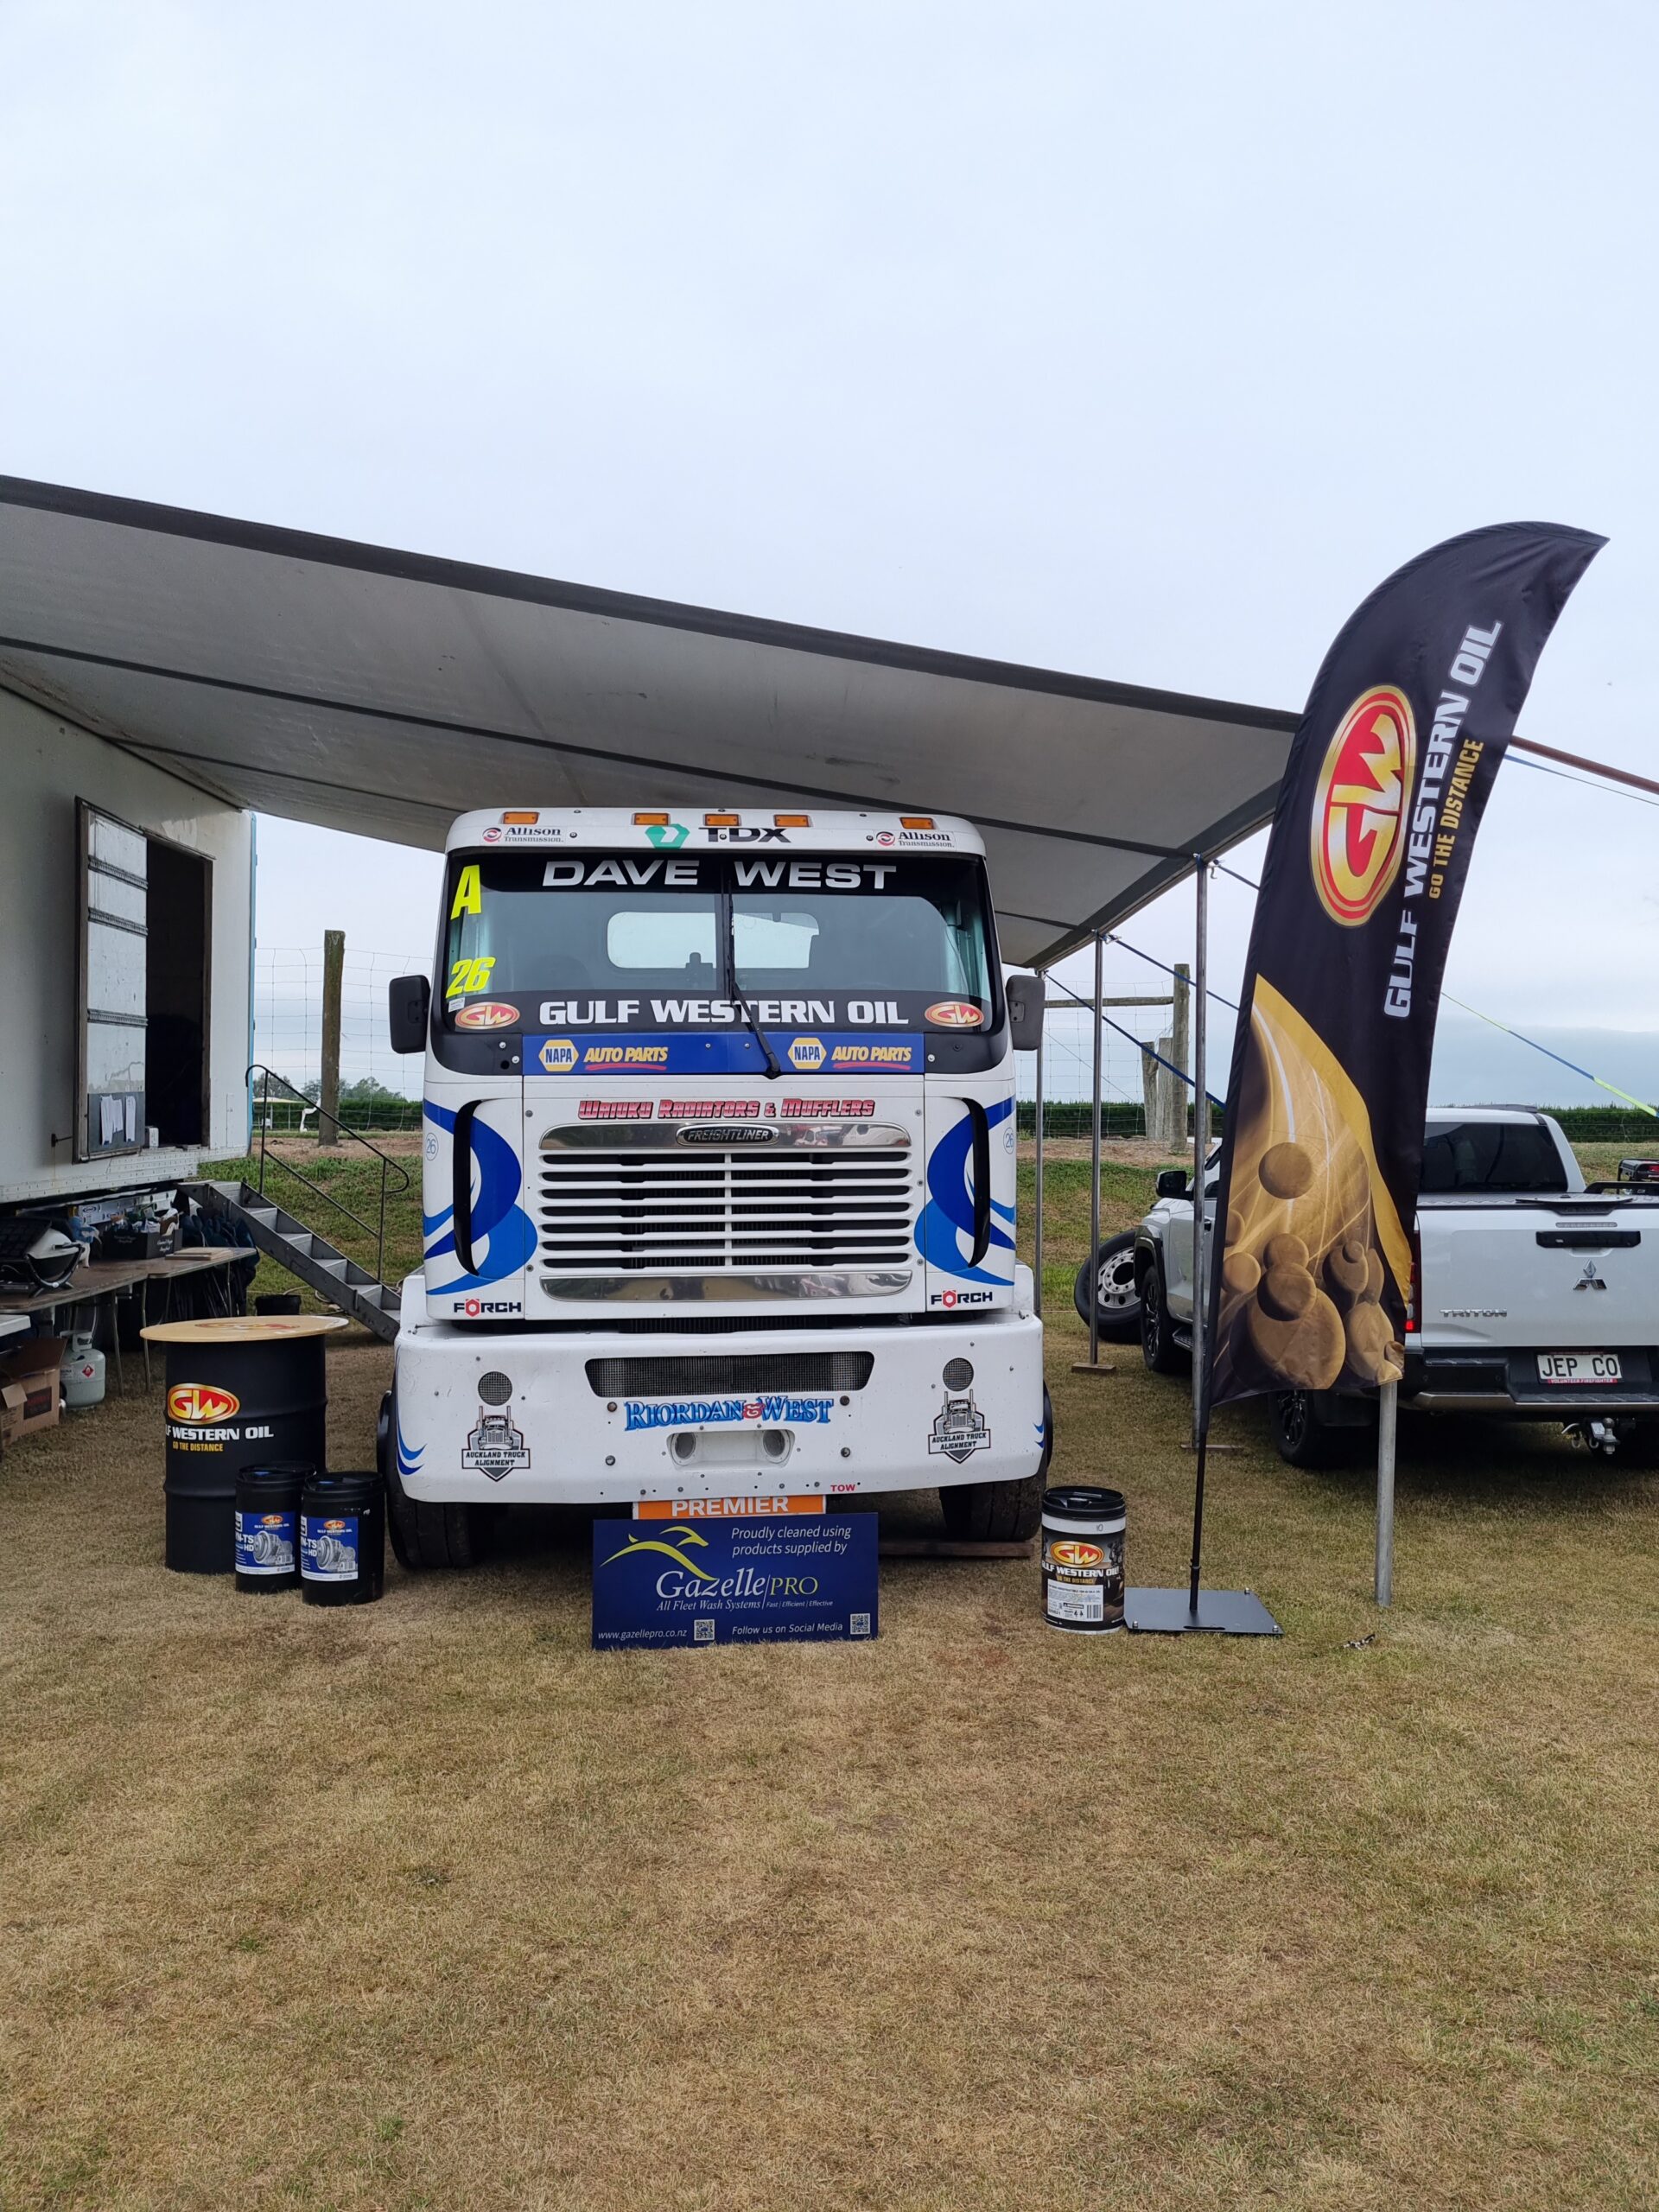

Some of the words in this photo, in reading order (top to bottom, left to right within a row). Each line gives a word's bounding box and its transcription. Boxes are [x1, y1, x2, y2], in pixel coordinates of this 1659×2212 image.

[1440, 738, 1484, 830] DISTANCE
[1320, 698, 1409, 914] GW
[1383, 908, 1419, 1019] GULF
[1403, 689, 1471, 899] WESTERN
[1450, 620, 1503, 687] OIL
[505, 827, 562, 836] Allison
[698, 827, 791, 843] TDX
[899, 831, 950, 841] Allison
[1433, 833, 1455, 868] THE
[543, 860, 700, 887] DAVE
[734, 861, 897, 889] WEST
[450, 864, 481, 920] A
[1429, 874, 1444, 899] GO
[446, 957, 496, 999] 26
[456, 1004, 516, 1027] GW
[539, 1000, 640, 1025] GULF
[650, 1000, 835, 1024] WESTERN
[847, 1001, 909, 1024] OIL
[927, 1003, 982, 1026] GW
[545, 1048, 573, 1063] NAPA
[584, 1047, 624, 1063] AUTO
[625, 1046, 668, 1062] PARTS
[794, 1046, 821, 1061] NAPA
[831, 1046, 869, 1061] AUTO
[870, 1046, 912, 1062] PARTS
[764, 1103, 776, 1117] &
[687, 1128, 770, 1141] FREIGHTLINER
[1005, 1133, 1014, 1148] 26
[426, 1138, 435, 1154] 26
[1440, 1309, 1507, 1318] TRITON
[1542, 1357, 1578, 1376] JEP
[169, 1387, 232, 1421] GW
[625, 1401, 744, 1431] RIORDAN
[759, 1395, 834, 1424] WEST
[172, 1427, 240, 1440] WESTERN
[245, 1426, 274, 1440] OIL
[931, 1433, 964, 1443] AUCKLAND
[966, 1432, 987, 1440] TRUCK
[180, 1441, 189, 1451] THE
[190, 1443, 224, 1452] DISTANCE
[940, 1440, 977, 1450] ALIGNMENT
[671, 1496, 789, 1516] PREMIER
[732, 1526, 775, 1541] Proudly
[777, 1525, 821, 1538] cleaned
[823, 1525, 851, 1539] using
[732, 1542, 782, 1558] products
[785, 1541, 832, 1556] supplied
[834, 1541, 848, 1555] by
[1052, 1543, 1101, 1566] GW
[1057, 1566, 1103, 1578] WESTERN
[656, 1567, 766, 1599] Gazelle
[770, 1576, 818, 1596] PRO
[657, 1600, 671, 1611] All
[673, 1600, 696, 1610] Fleet
[699, 1599, 723, 1610] Wash
[725, 1599, 760, 1612] Systems
[598, 1629, 688, 1641] www.gazellepro.co.nz
[732, 1625, 760, 1635] Follow
[788, 1624, 815, 1632] Social
[817, 1623, 843, 1631] Media
